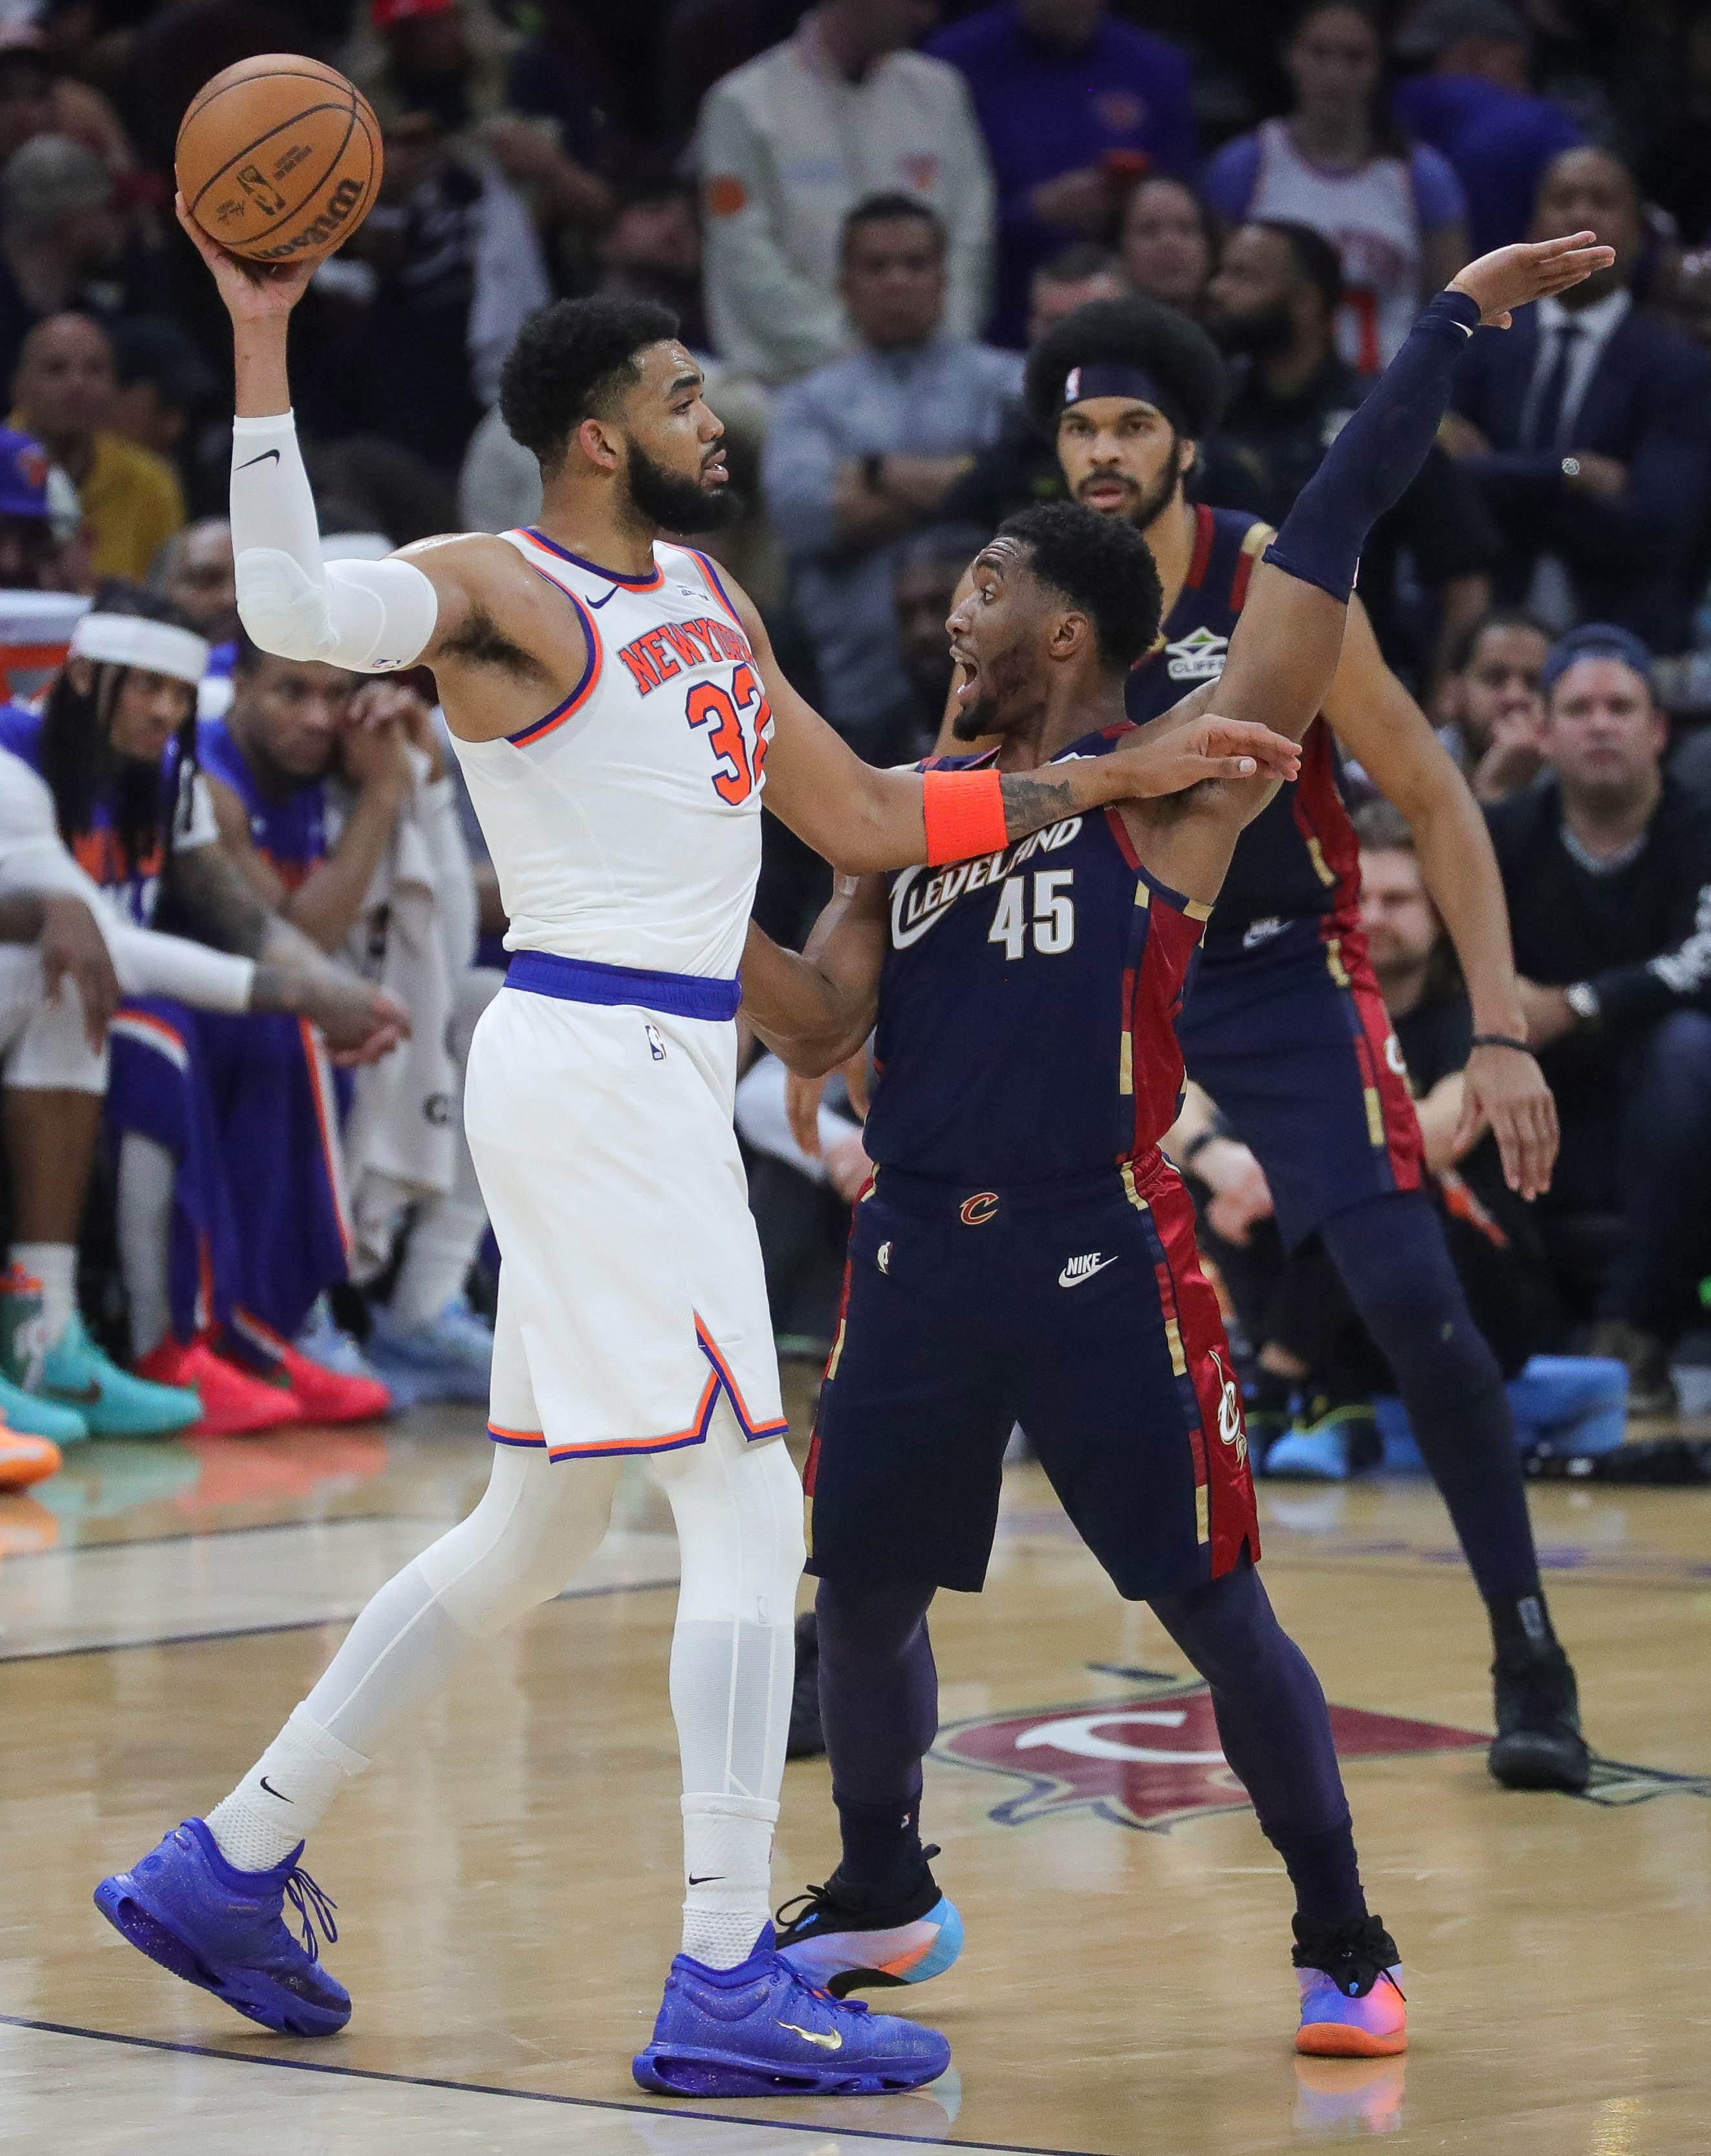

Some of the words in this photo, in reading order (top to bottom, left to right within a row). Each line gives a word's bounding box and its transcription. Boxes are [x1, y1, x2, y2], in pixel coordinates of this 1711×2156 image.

[616, 622, 705, 699] NEW
[685, 663, 772, 806] 32
[889, 816, 1082, 949] CLEVELAND
[988, 869, 1074, 960] 45
[959, 1192, 999, 1224] C
[1067, 1252, 1101, 1275] NIKE
